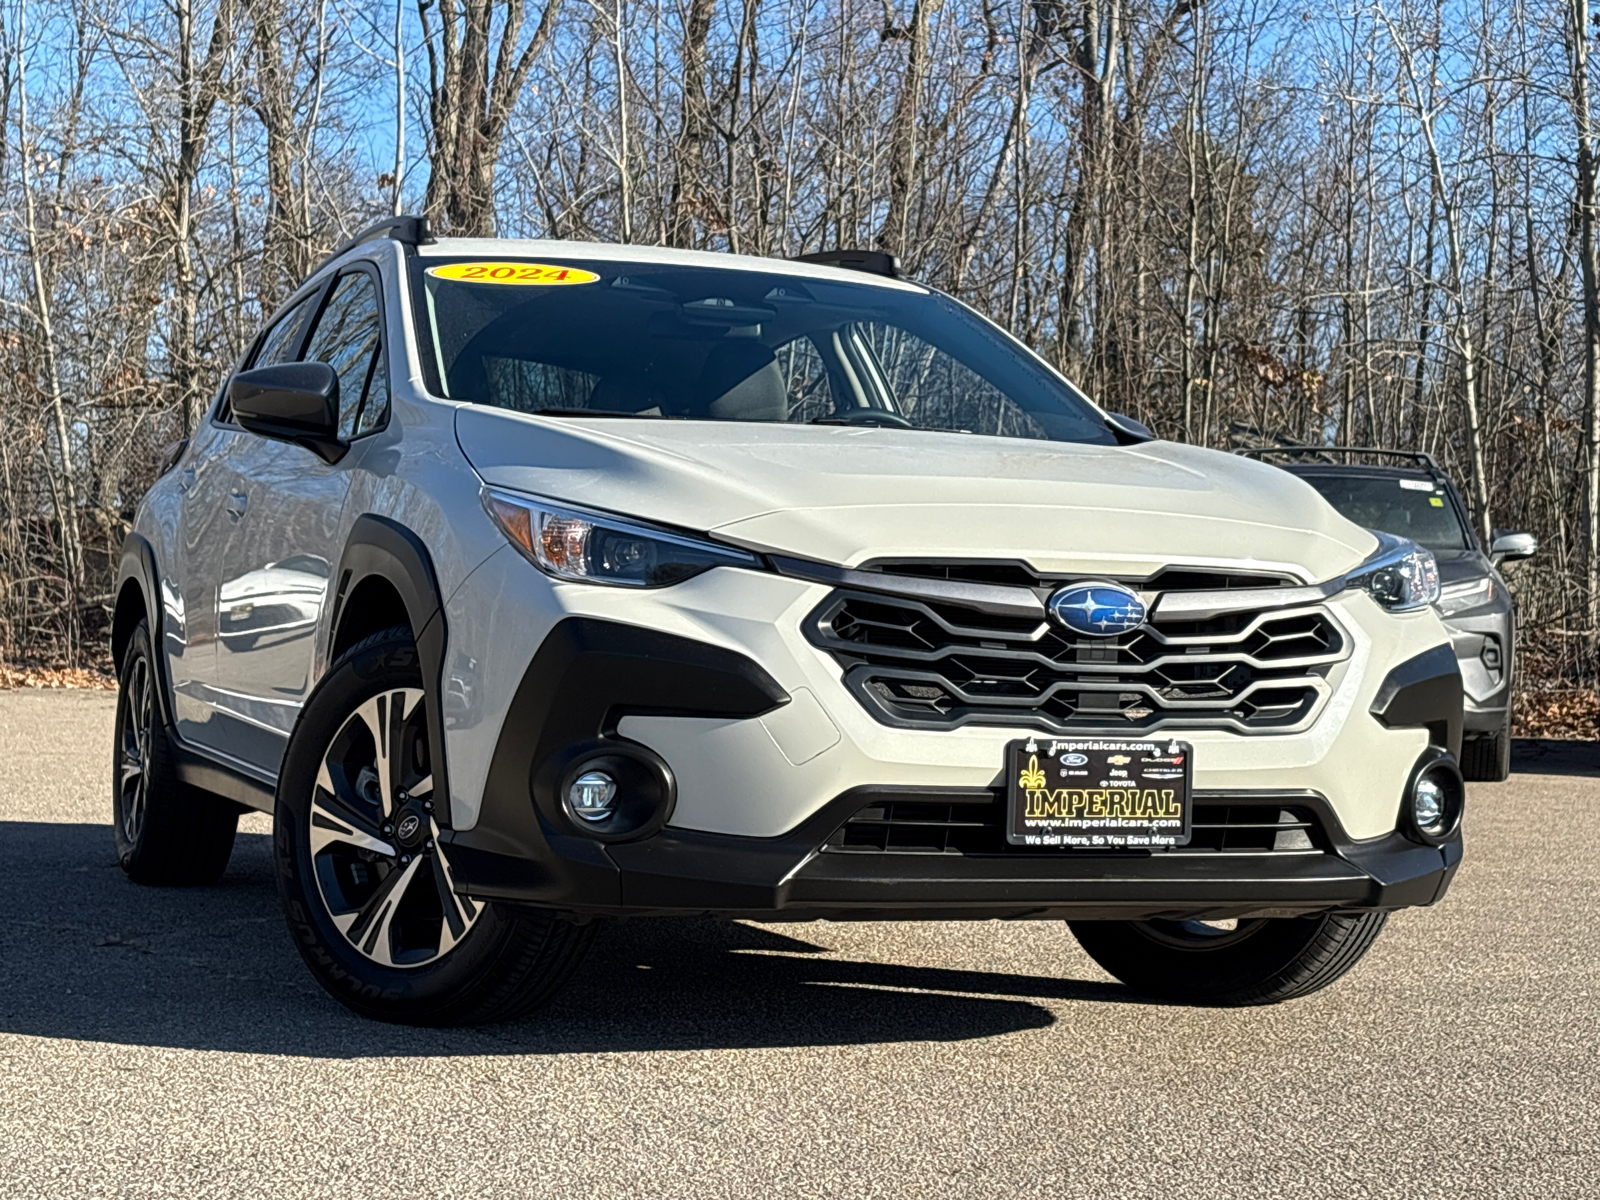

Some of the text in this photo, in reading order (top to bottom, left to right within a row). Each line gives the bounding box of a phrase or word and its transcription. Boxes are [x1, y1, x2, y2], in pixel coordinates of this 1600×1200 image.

[461, 267, 572, 280] 2024
[1051, 741, 1155, 752] Imperialcars.com
[1025, 789, 1181, 818] IMPERIAL
[1025, 818, 1181, 829] www.imperialcars.com
[1025, 835, 1175, 846] We Sell More, So You Save More
